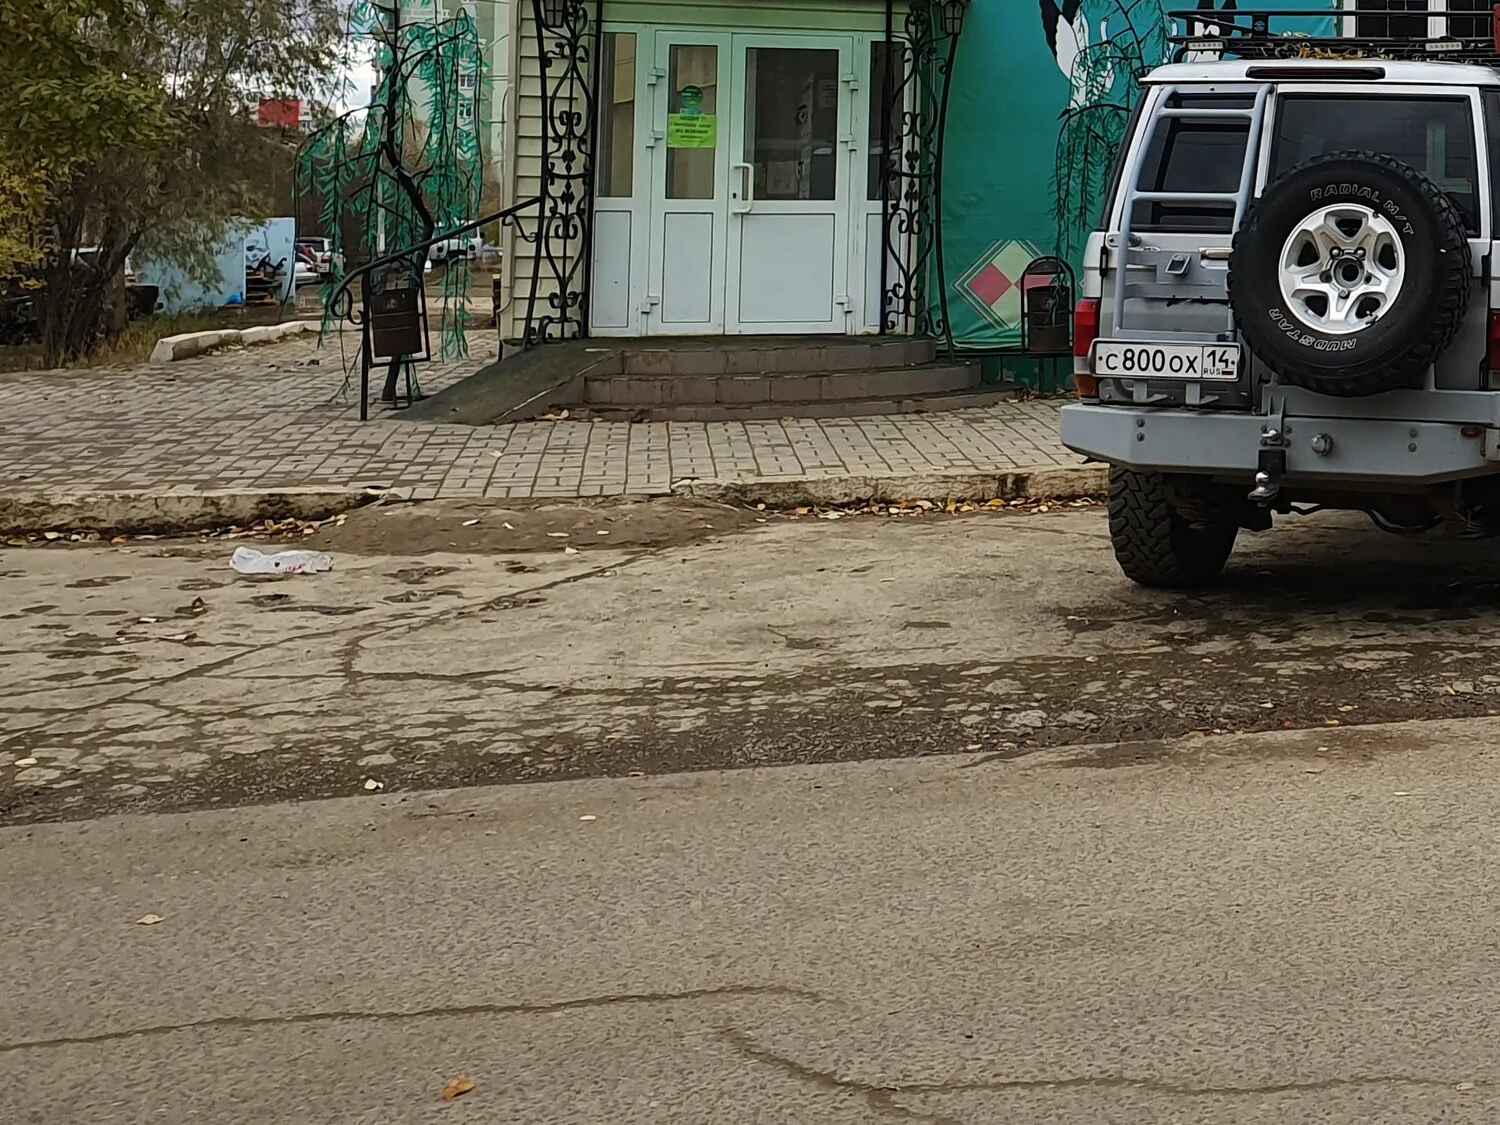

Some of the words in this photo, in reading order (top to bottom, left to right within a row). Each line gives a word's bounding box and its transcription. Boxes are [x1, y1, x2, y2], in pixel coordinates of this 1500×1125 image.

[1310, 183, 1380, 202] RADIAL
[1383, 199, 1414, 235] M/T
[1268, 308, 1357, 351] MUDSTAR
[1206, 349, 1229, 368] 14
